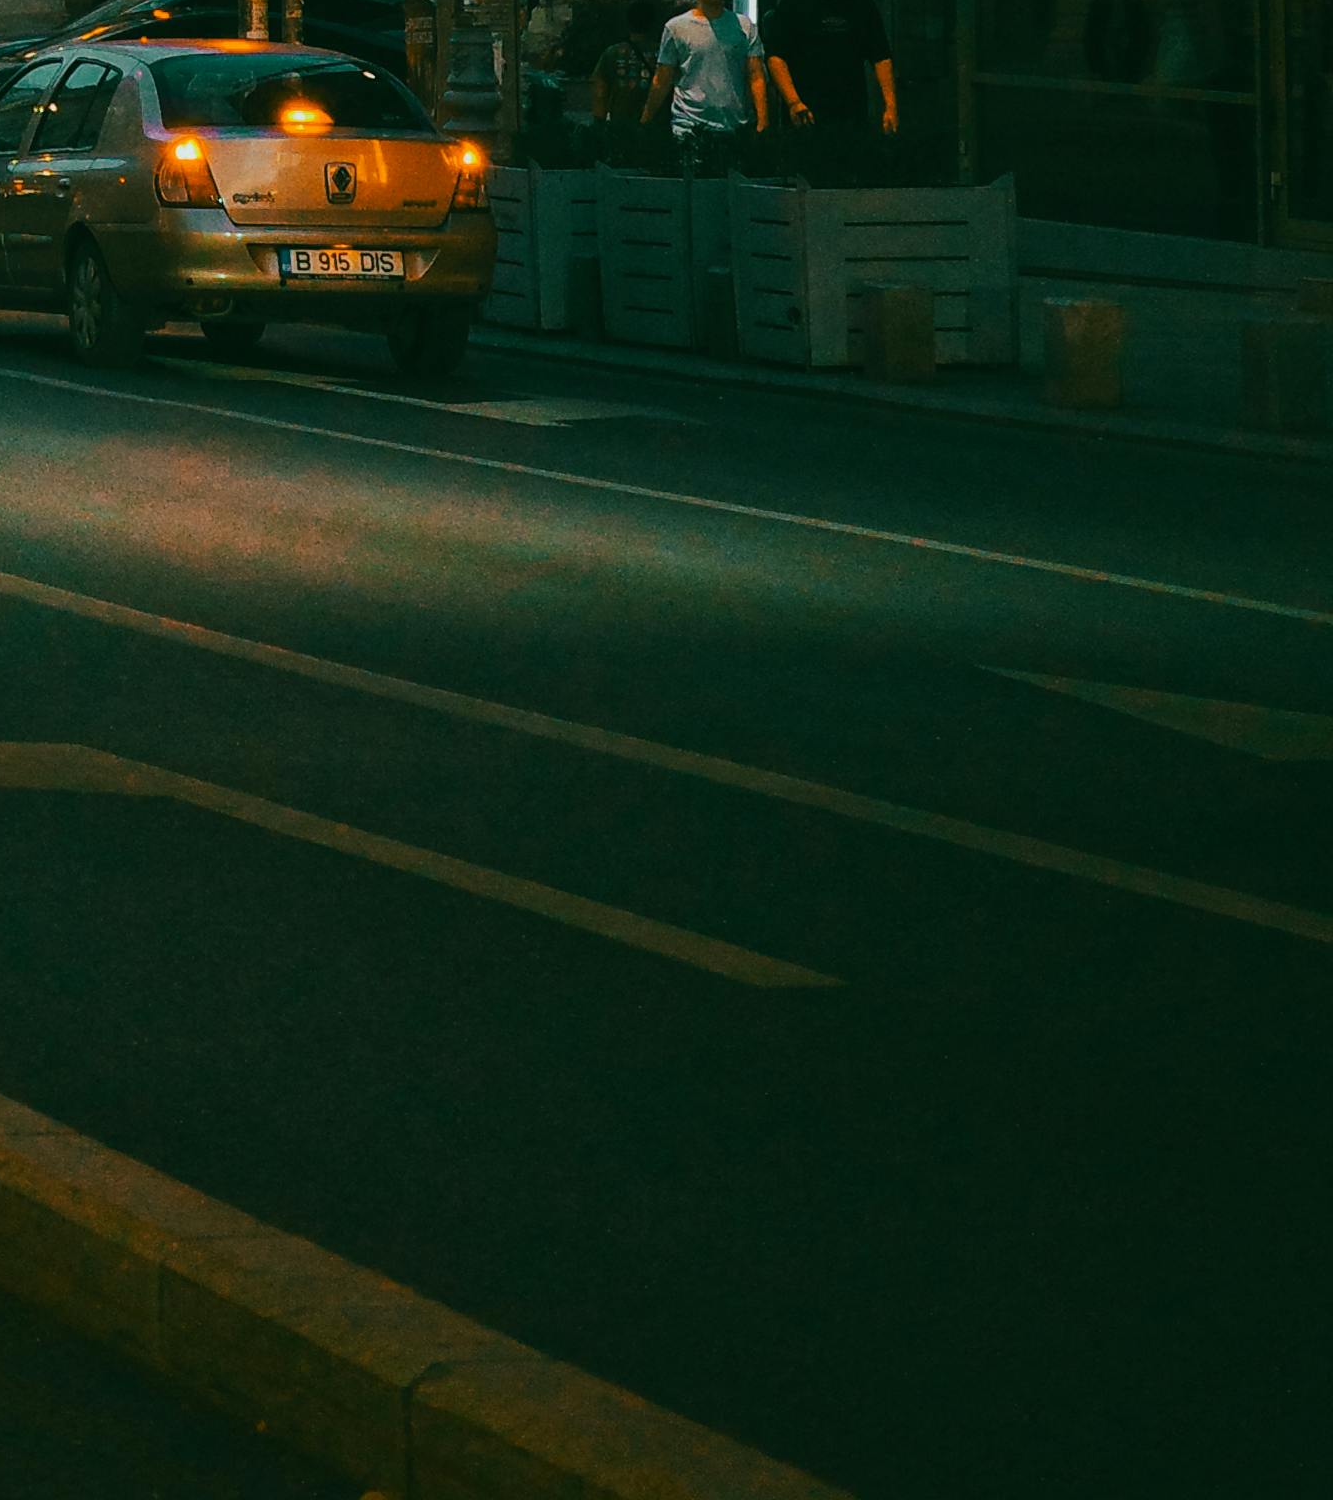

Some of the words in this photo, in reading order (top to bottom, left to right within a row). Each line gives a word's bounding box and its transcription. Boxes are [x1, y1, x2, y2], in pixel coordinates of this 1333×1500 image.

[295, 251, 311, 271] B
[318, 252, 351, 272] 915
[360, 252, 395, 273] DIS
